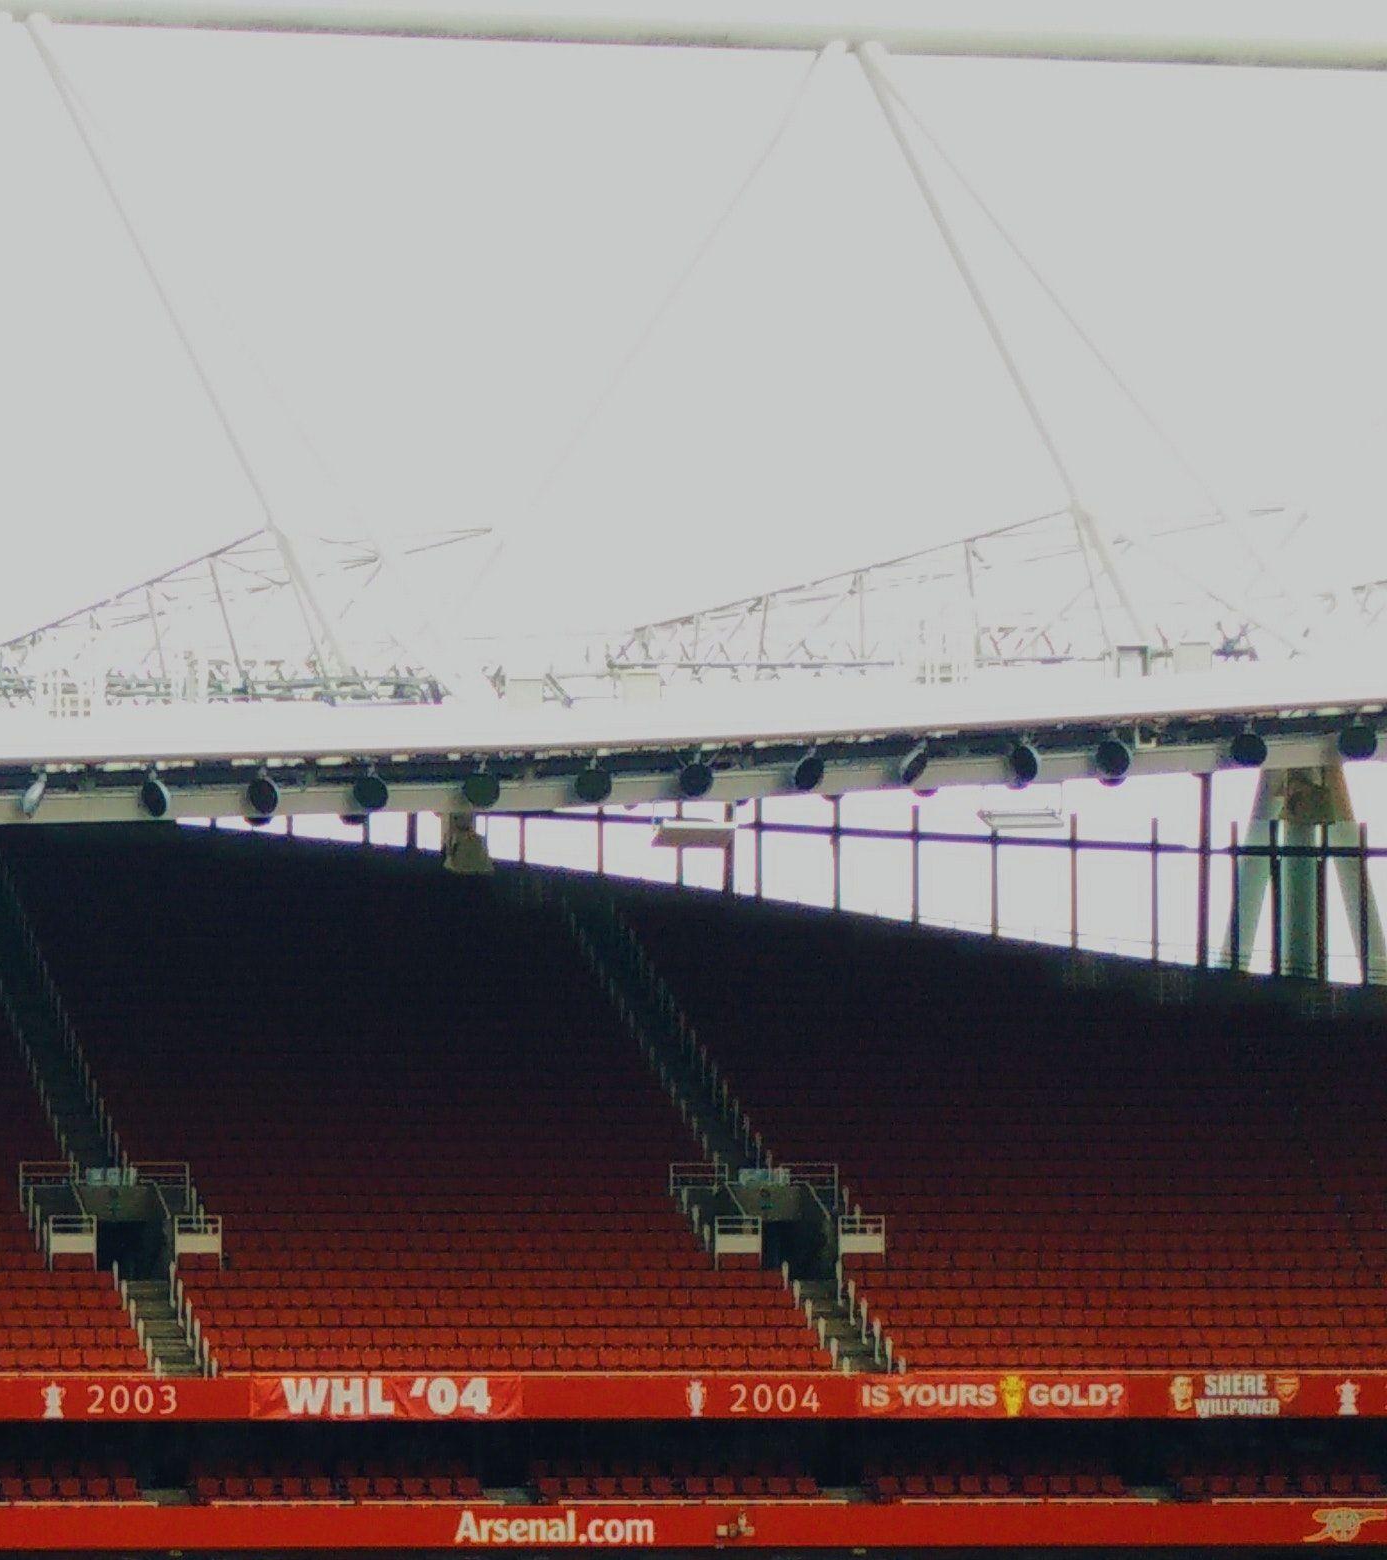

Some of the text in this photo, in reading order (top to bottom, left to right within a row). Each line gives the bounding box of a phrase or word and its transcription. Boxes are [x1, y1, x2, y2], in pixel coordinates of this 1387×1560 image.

[87, 1385, 178, 1414] 2003
[281, 1377, 395, 1415] WHL
[729, 1384, 821, 1413] 2004
[861, 1383, 1124, 1408] IS YOURS GOLD?
[454, 1511, 655, 1545] Arsenal.com
